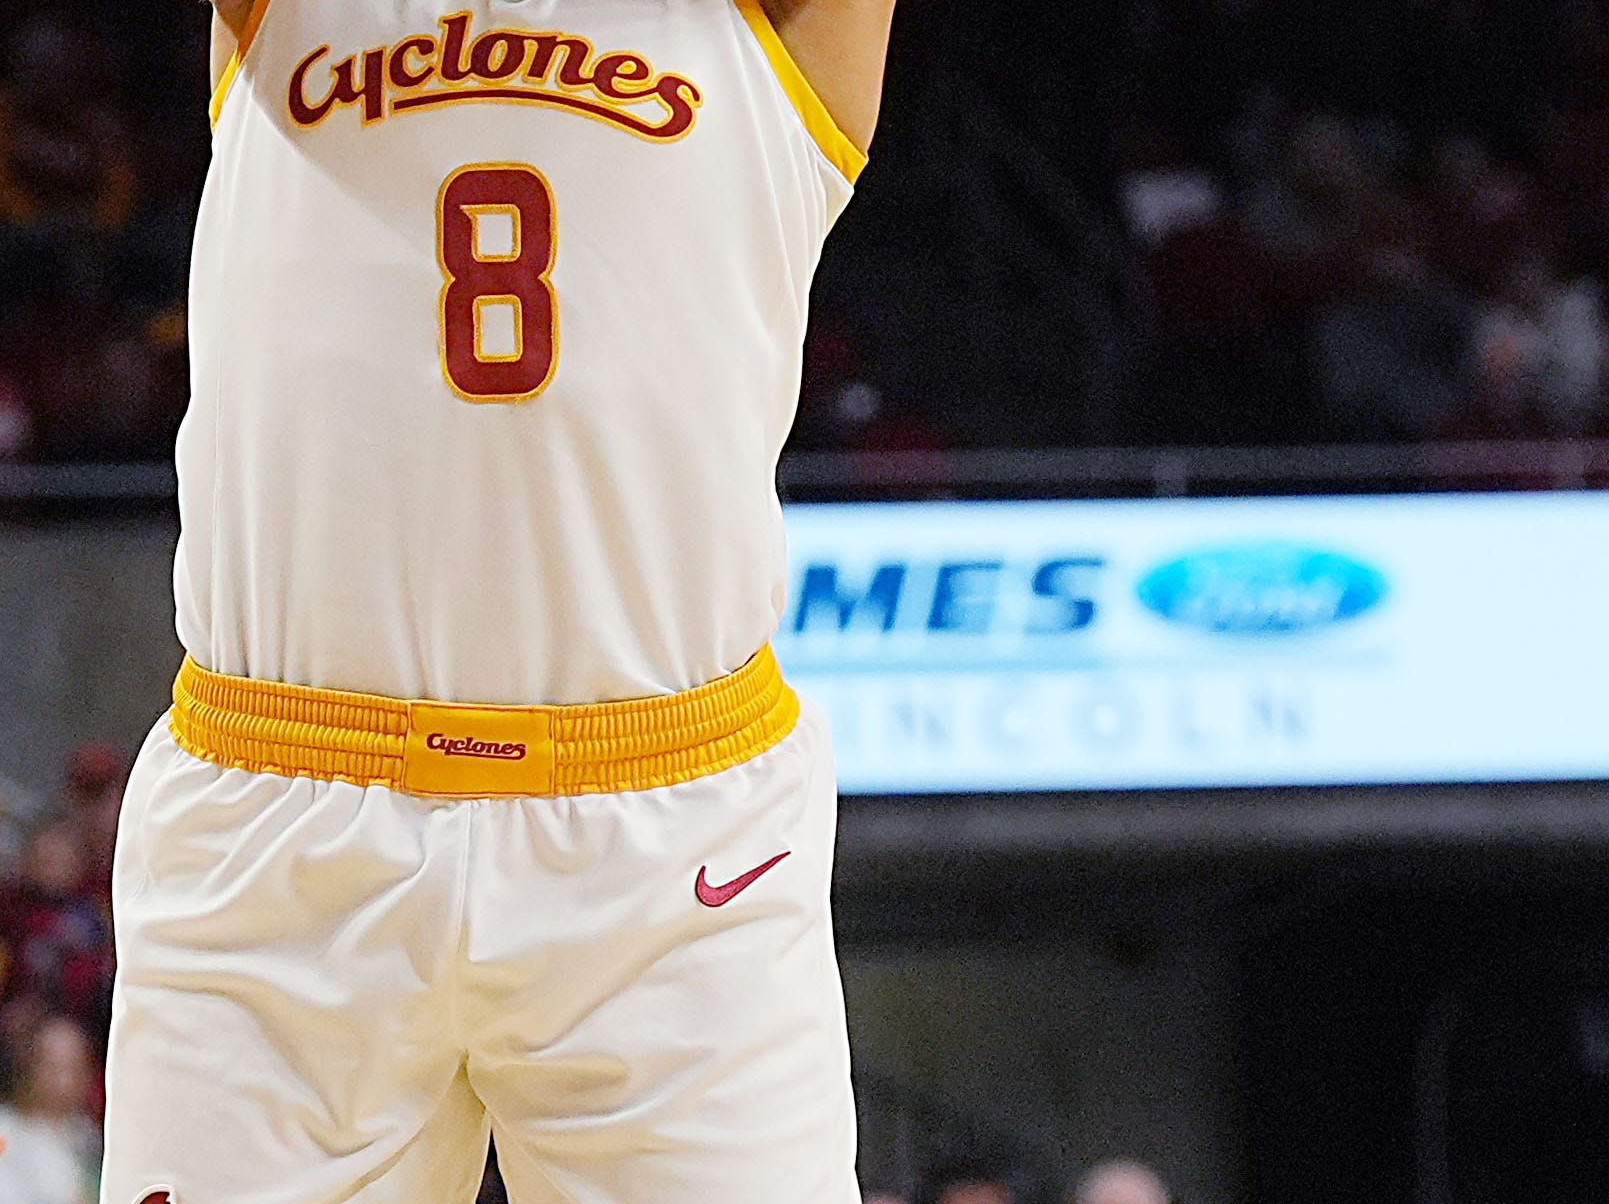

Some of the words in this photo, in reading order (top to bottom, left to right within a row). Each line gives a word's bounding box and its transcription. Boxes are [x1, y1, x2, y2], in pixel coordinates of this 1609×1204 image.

[288, 10, 704, 144] Cyclones
[435, 160, 560, 404] 8
[426, 732, 526, 761] Cyclones
